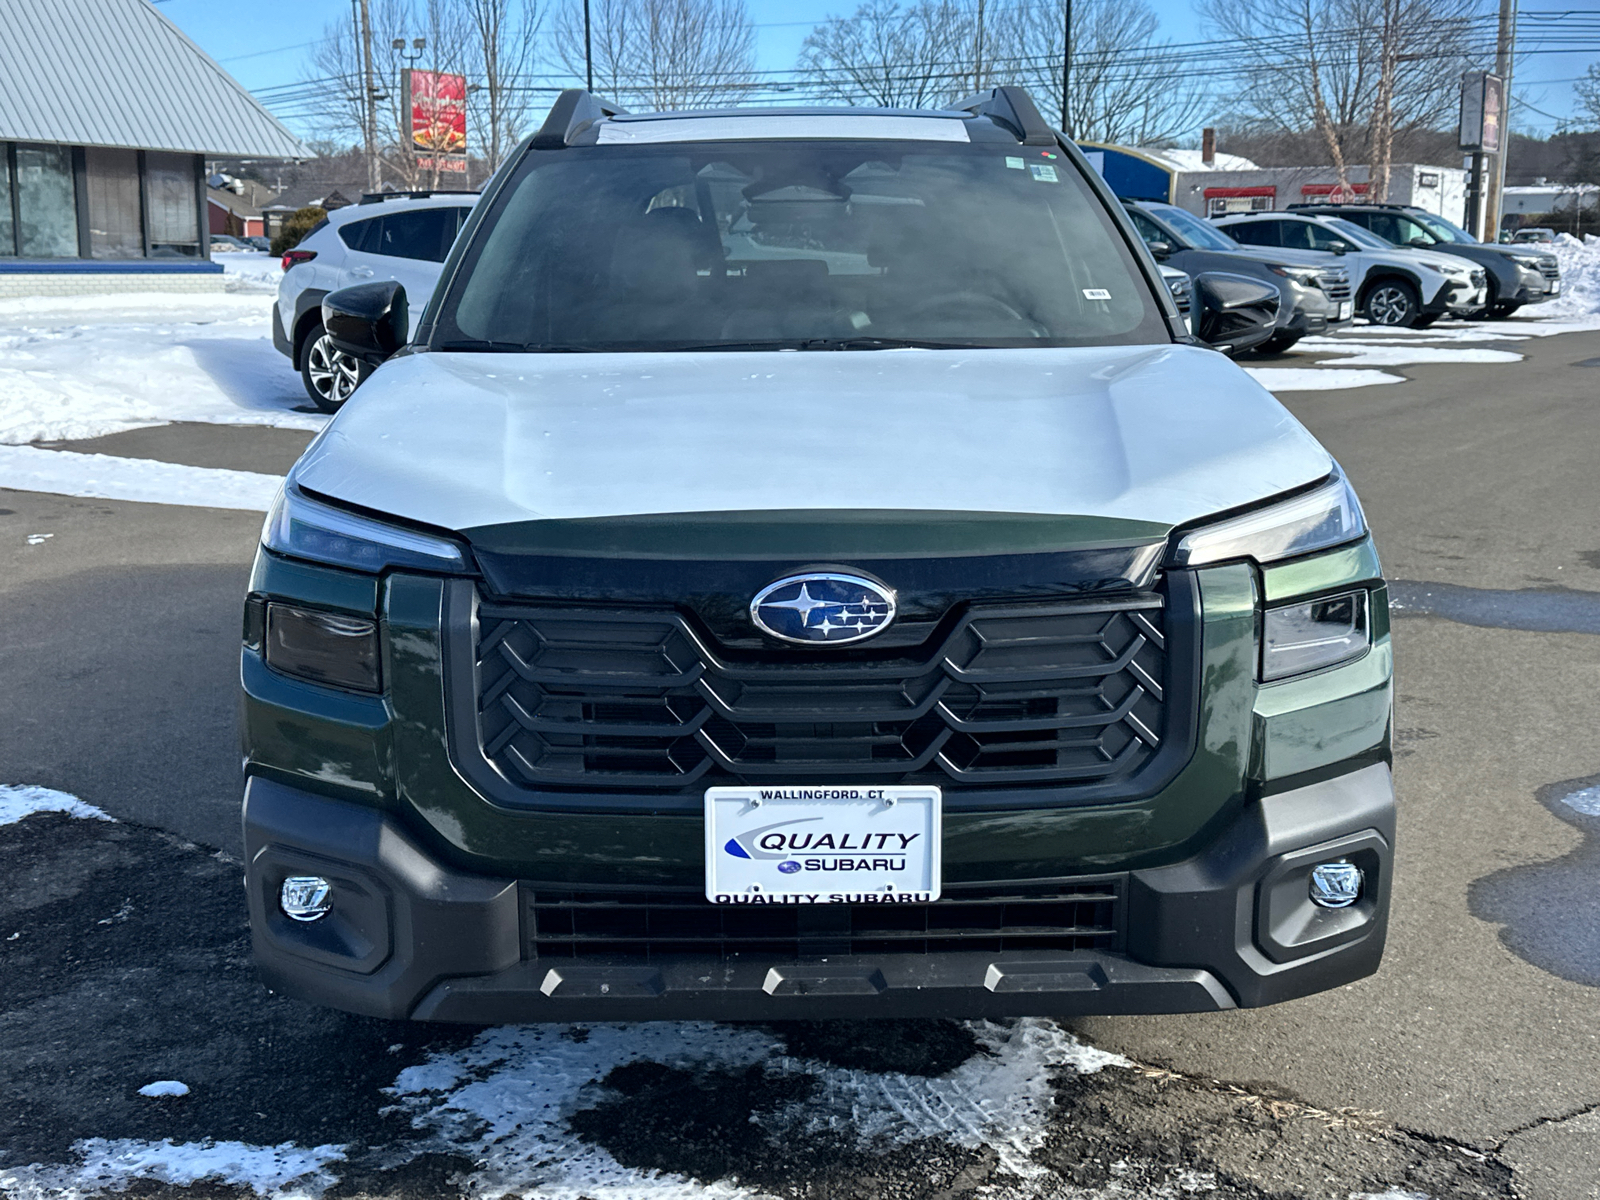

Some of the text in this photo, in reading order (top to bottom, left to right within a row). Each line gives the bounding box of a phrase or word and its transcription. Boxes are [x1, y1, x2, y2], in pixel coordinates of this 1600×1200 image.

[760, 790, 885, 800] WALLINGFORD, CT
[760, 833, 921, 851] QUALITY
[804, 859, 906, 871] SUBARU
[715, 893, 930, 904] QUALITY SUBARU
